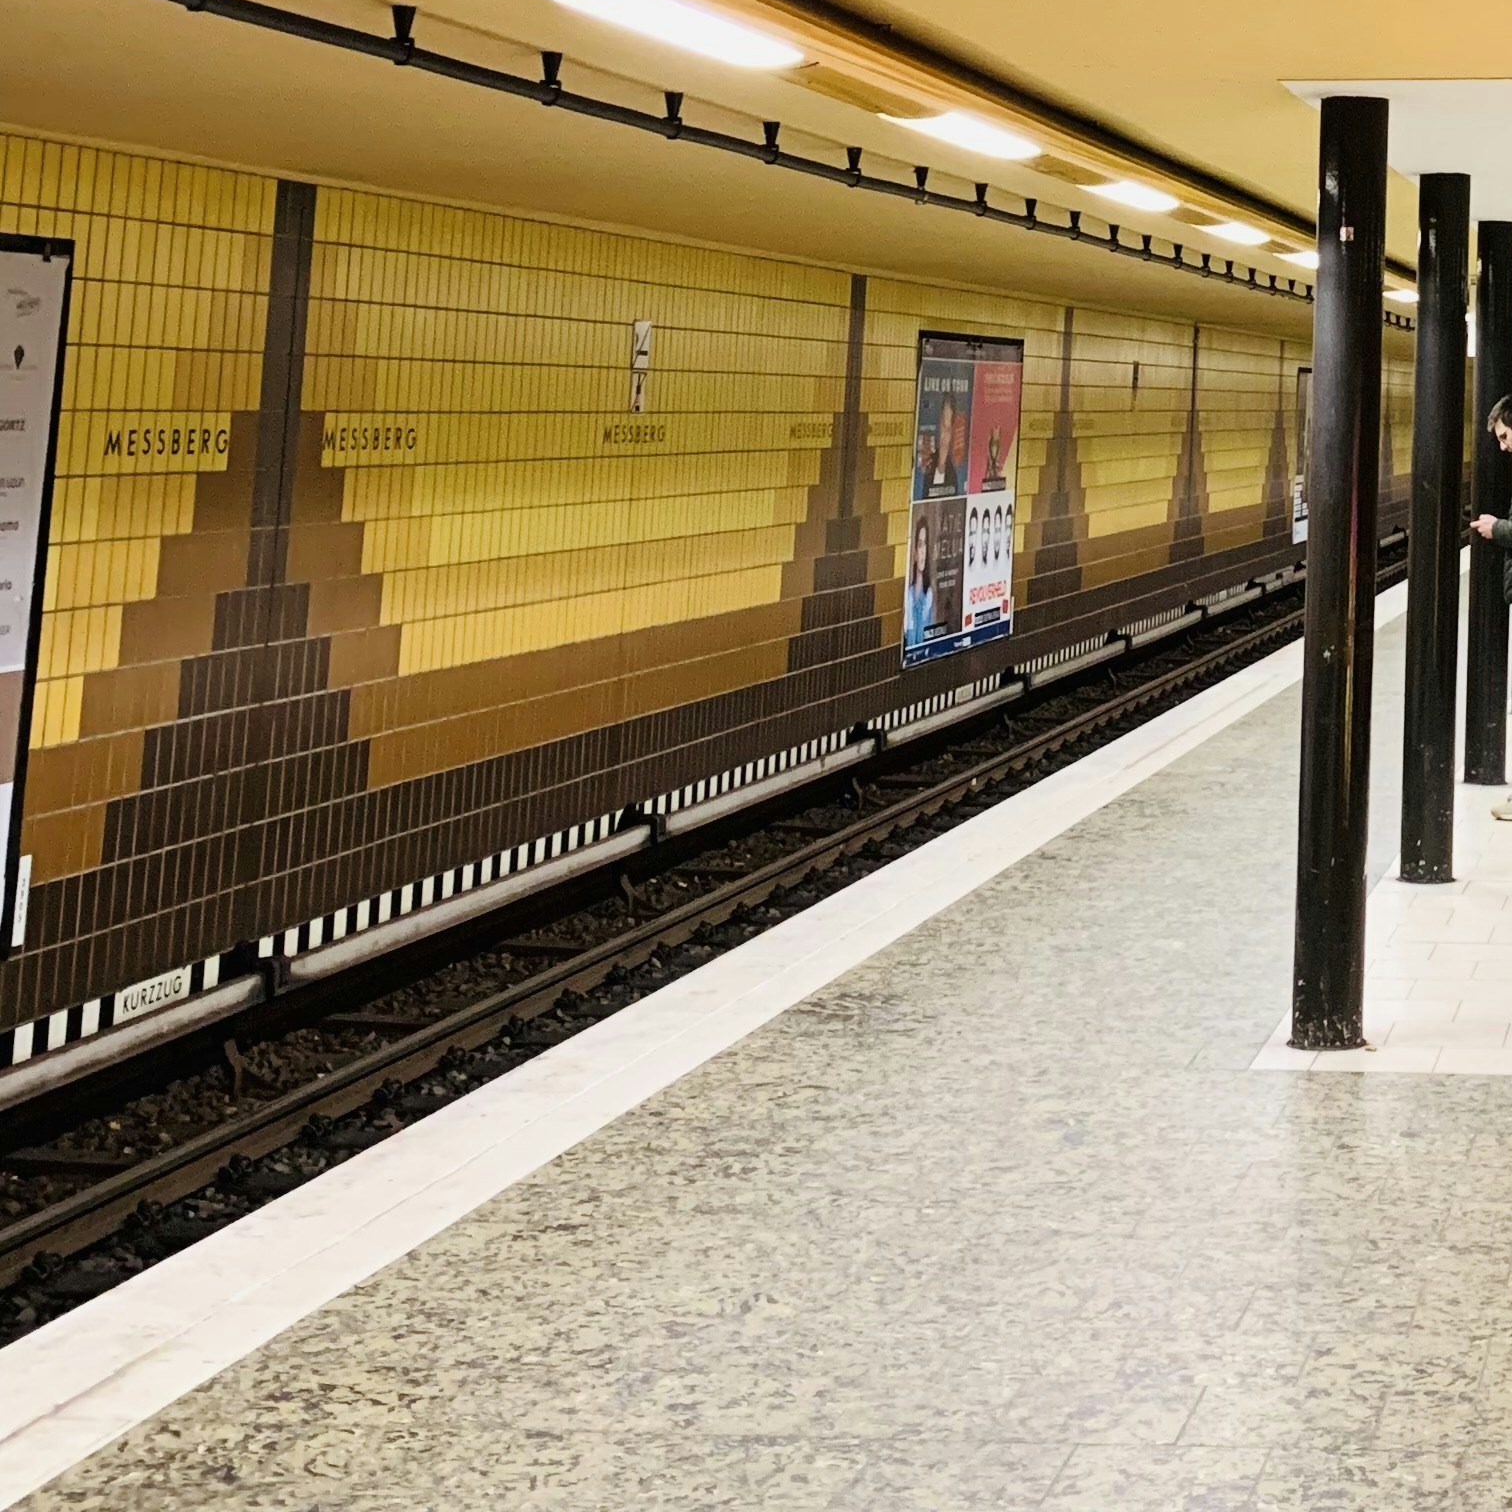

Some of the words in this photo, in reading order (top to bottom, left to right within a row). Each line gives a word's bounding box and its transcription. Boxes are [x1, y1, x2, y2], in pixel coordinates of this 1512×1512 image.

[104, 428, 229, 456] MESSBERG
[322, 427, 416, 452] MESSBERG
[602, 423, 666, 445] MESSBERG
[122, 975, 182, 1014] KURZZUG
